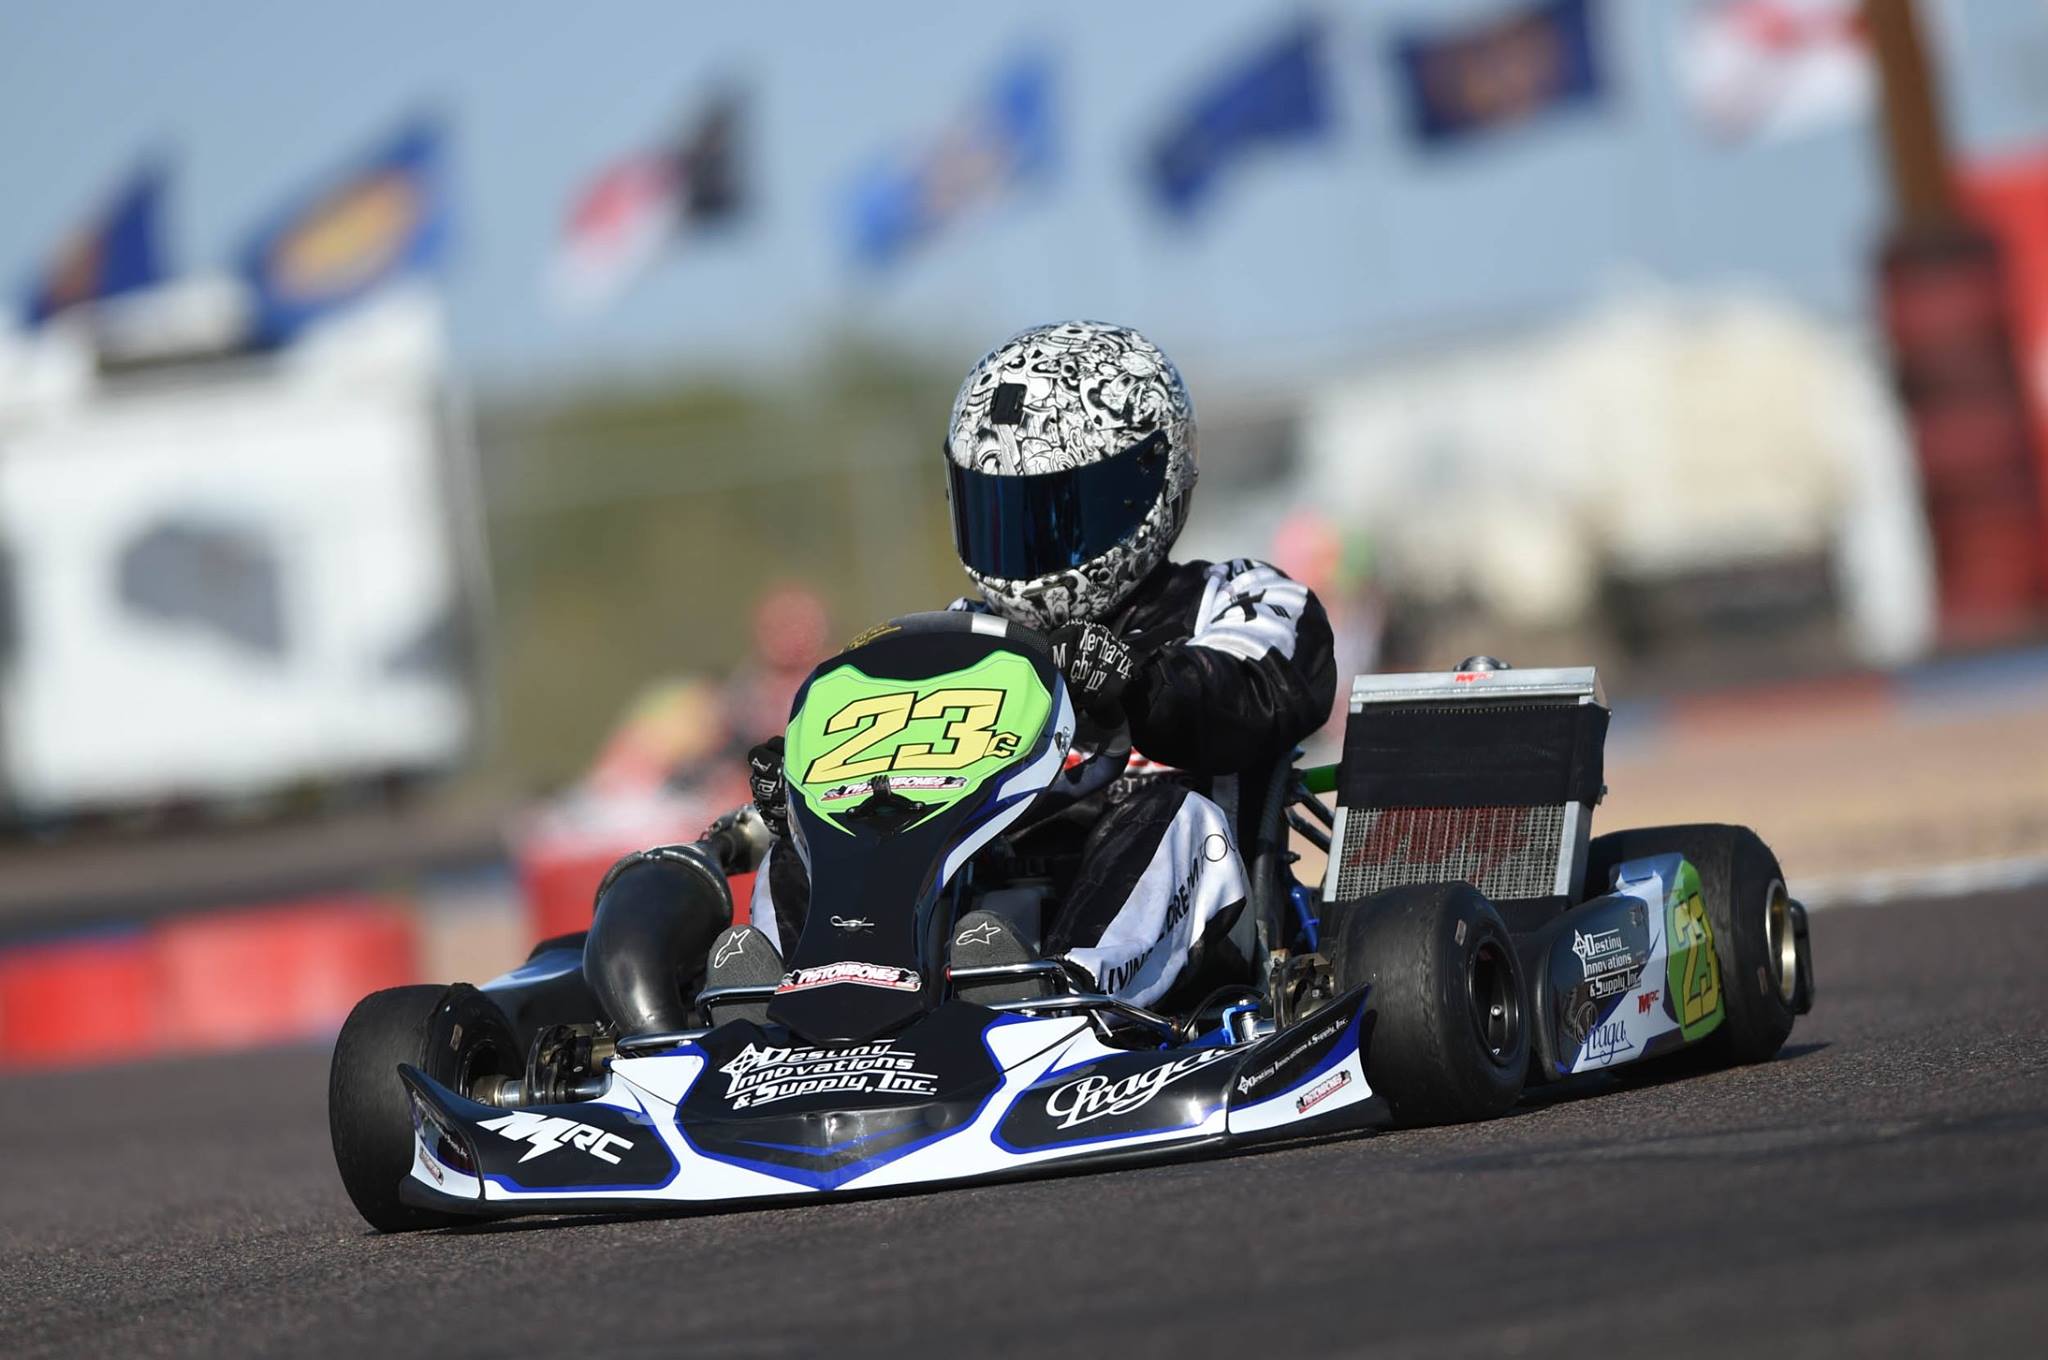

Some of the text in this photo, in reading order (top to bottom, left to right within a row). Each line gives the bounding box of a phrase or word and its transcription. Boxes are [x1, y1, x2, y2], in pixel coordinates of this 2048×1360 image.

[1583, 933, 1622, 956] Destiny
[1582, 952, 1632, 978] Innovations
[726, 1057, 915, 1096] Innovations
[875, 1070, 938, 1093] Inc.
[476, 1110, 635, 1165] MRC
